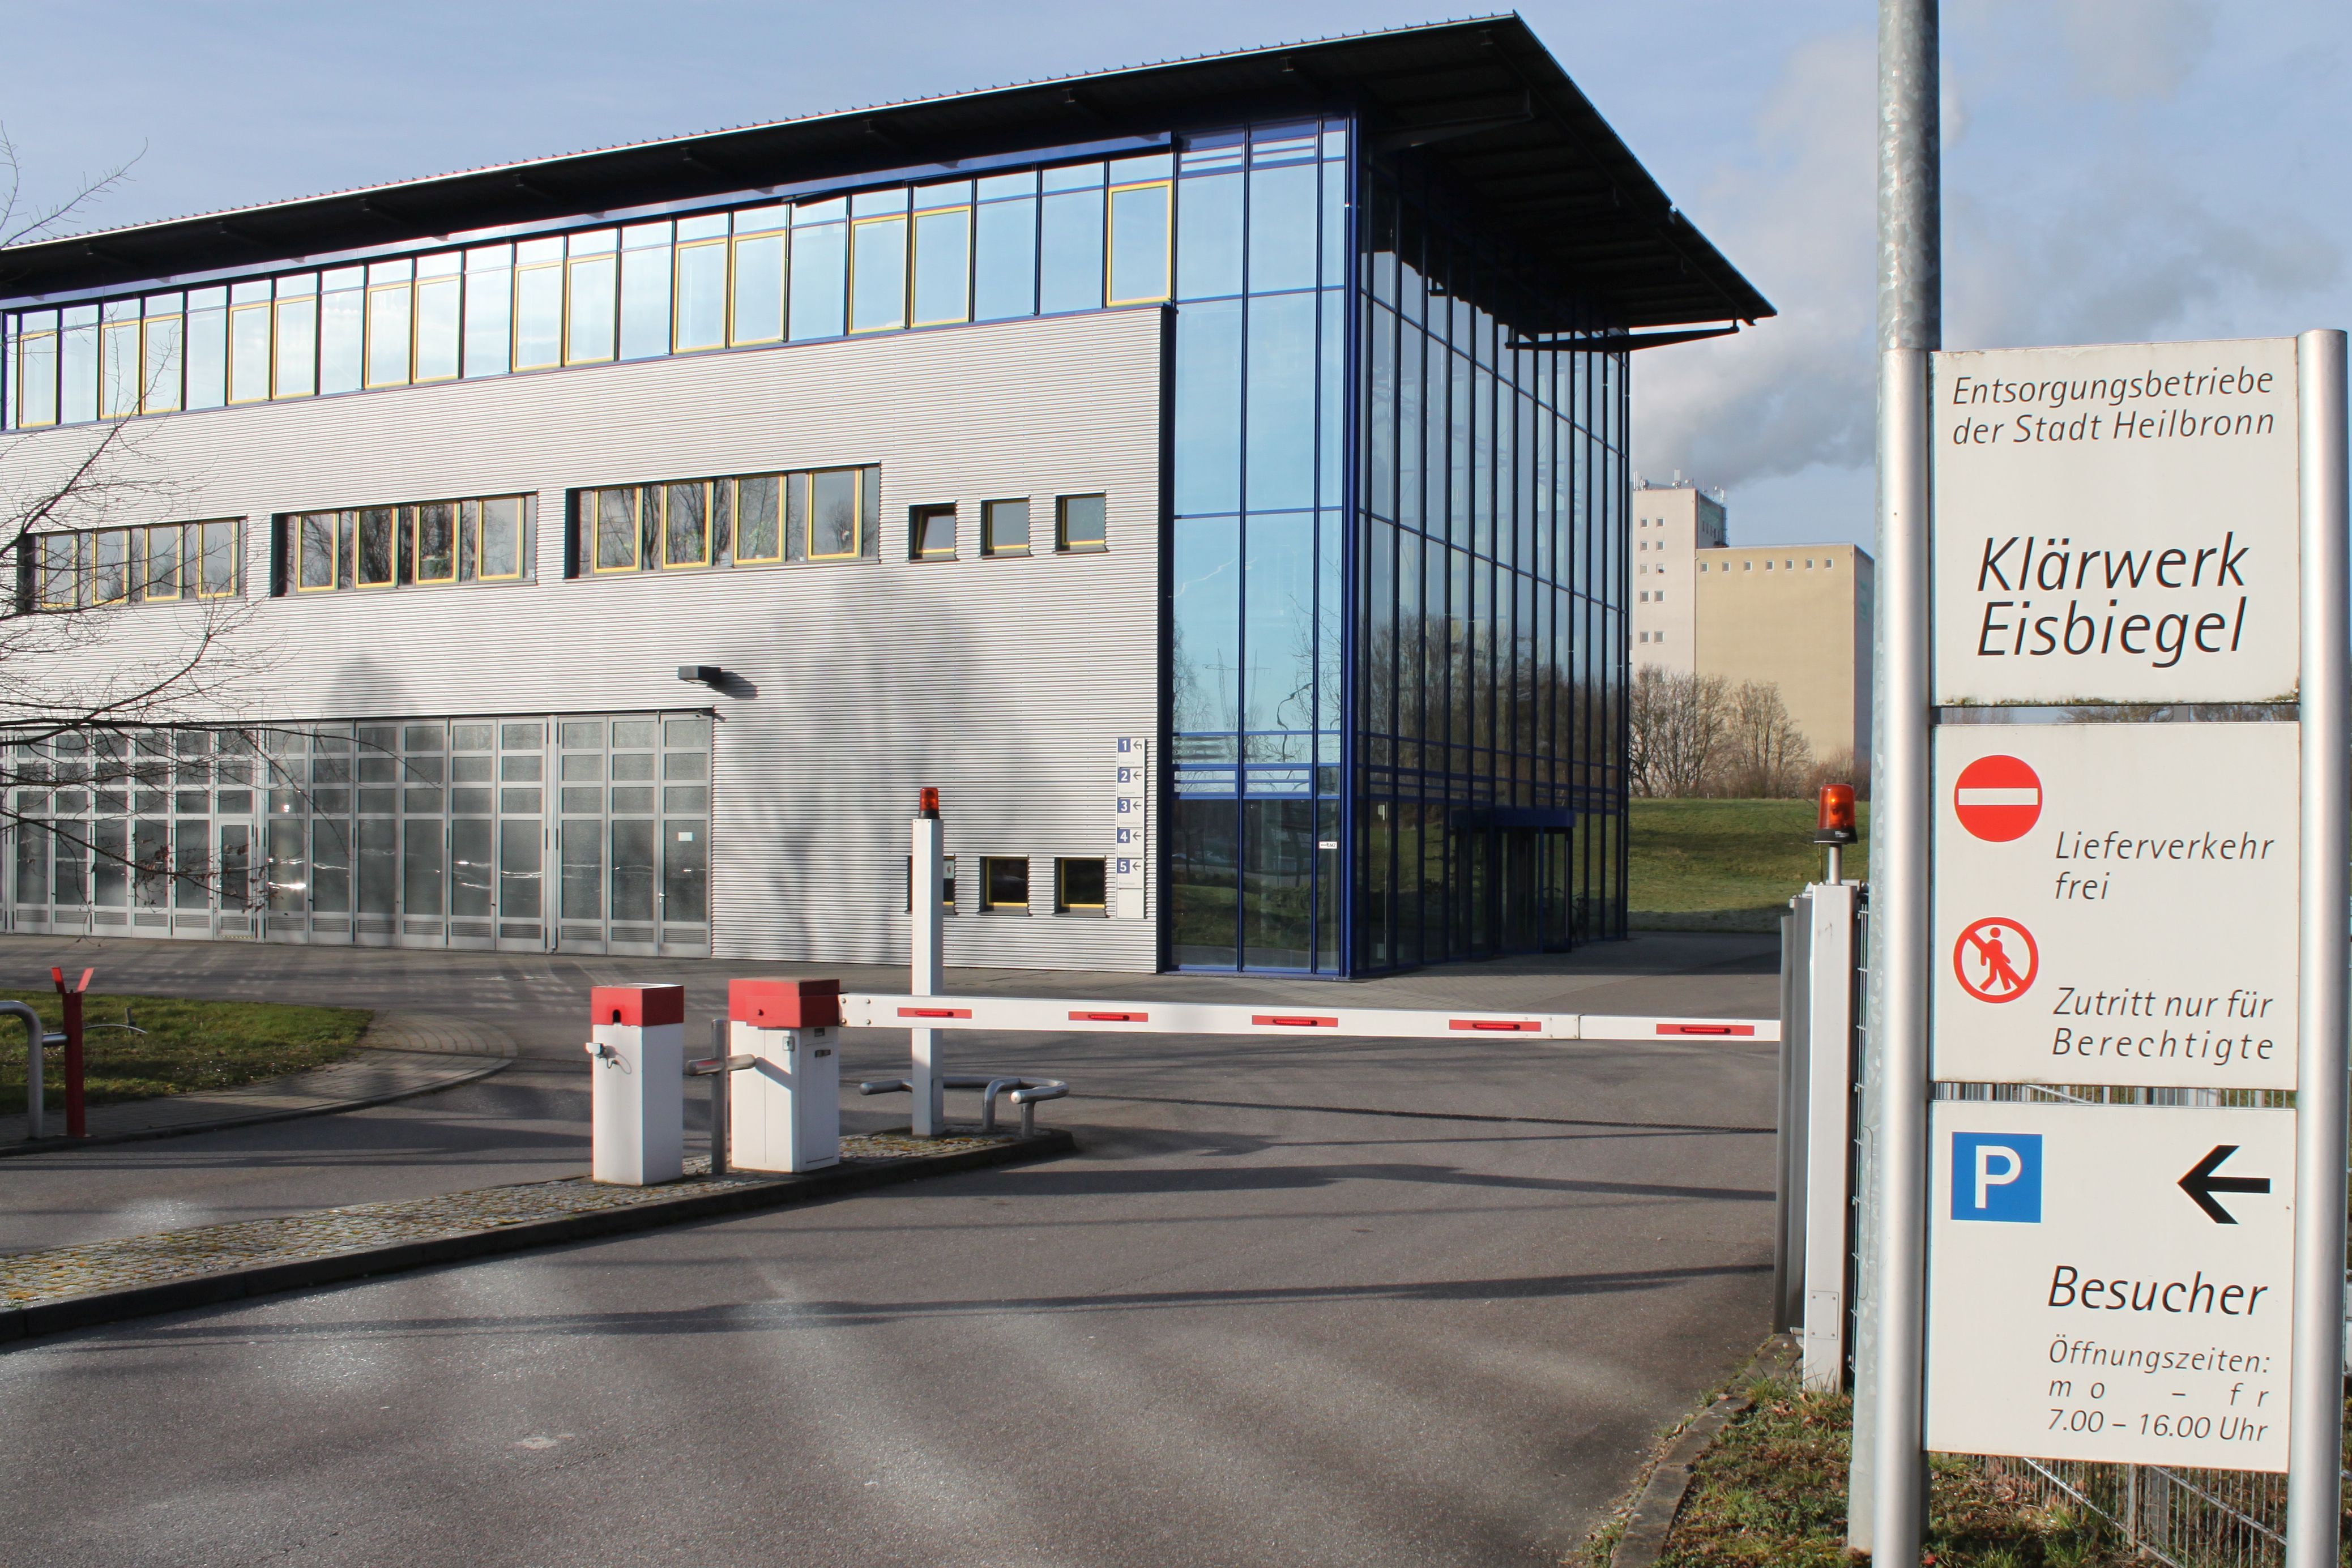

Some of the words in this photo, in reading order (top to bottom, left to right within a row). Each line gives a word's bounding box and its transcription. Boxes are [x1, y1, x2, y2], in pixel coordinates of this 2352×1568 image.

[1953, 365, 2273, 408] Entsorgungsbetriebe
[1953, 417, 2004, 445] der
[2013, 412, 2102, 443] Stadt
[2113, 408, 2274, 439] Heilbronn
[1977, 531, 2250, 592] Klärwerk
[1977, 595, 2247, 669] Eisbiegel
[1122, 740, 1127, 751] 1
[1121, 770, 1128, 781] 2
[1120, 801, 1128, 811] 3
[1120, 831, 1128, 842] 4
[2055, 830, 2275, 860] Lieferverkehr
[1120, 861, 1127, 872] 5
[2055, 871, 2111, 900] frei
[2052, 986, 2157, 1017] Zutritt
[2165, 996, 2219, 1018] nur
[2227, 989, 2274, 1019] für
[2052, 1027, 2273, 1066] Berechtigte
[1974, 1144, 2022, 1209] P
[2047, 1264, 2269, 1316] Besucher
[2049, 1333, 2270, 1374] Öffnungszeiten:
[2048, 1408, 2104, 1433] 7.00
[2140, 1413, 2211, 1439] 16.00
[2219, 1416, 2269, 1442] Uhr
